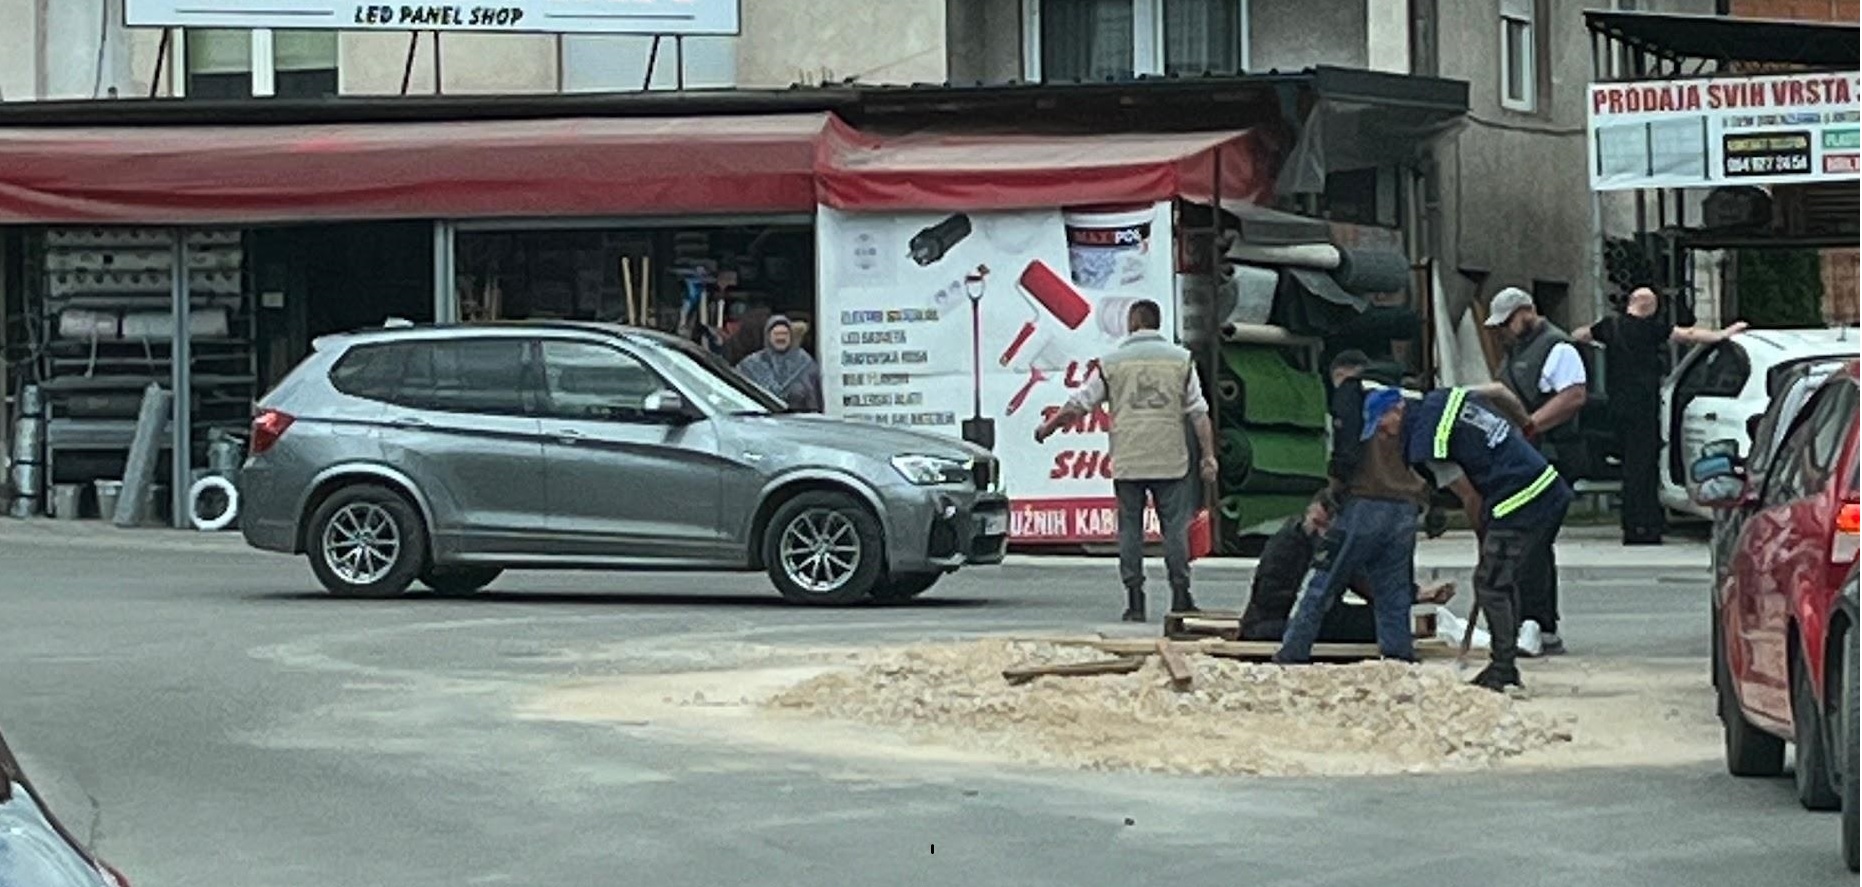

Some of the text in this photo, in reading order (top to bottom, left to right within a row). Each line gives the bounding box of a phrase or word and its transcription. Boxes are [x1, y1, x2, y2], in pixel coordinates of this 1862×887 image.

[354, 5, 523, 26] LED PANEL SHOP
[1593, 84, 1702, 115] PRODAJA
[1706, 82, 1765, 110] SVIH
[1771, 78, 1851, 106] VRSTA
[1010, 504, 1067, 537] UŽNIH
